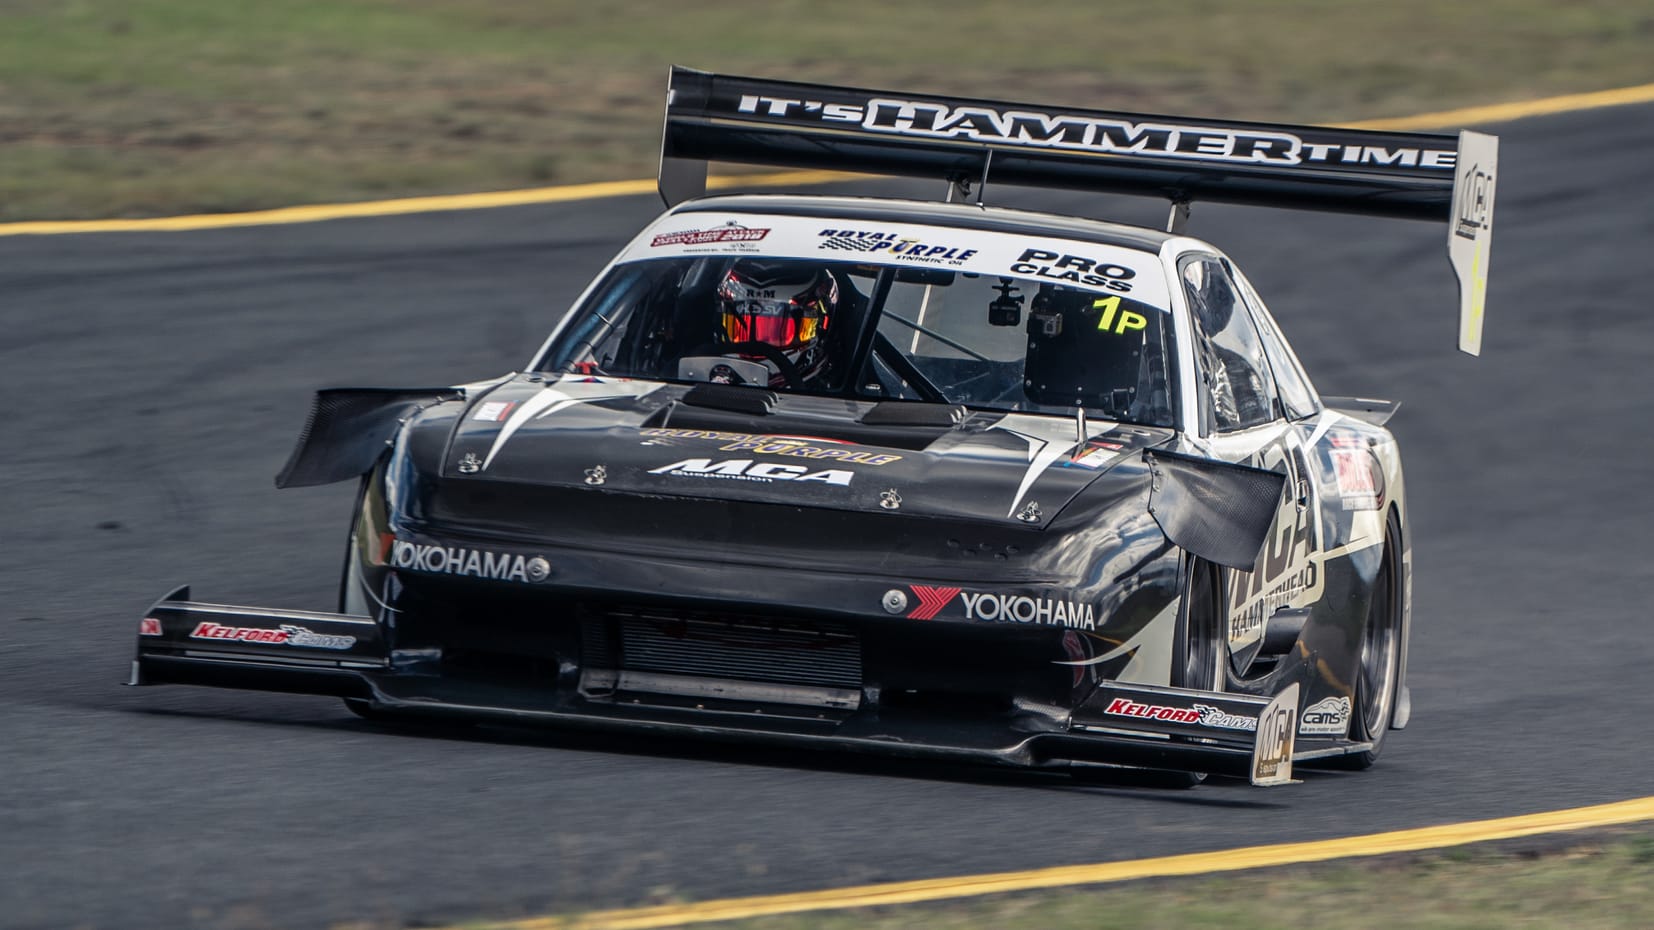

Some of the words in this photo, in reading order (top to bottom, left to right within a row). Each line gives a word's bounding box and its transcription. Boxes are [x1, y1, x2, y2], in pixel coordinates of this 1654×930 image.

[861, 98, 1303, 167] HAMMER
[1301, 142, 1458, 169] TIME
[818, 228, 898, 241] ROYAL
[869, 238, 979, 261] PURPLE
[895, 254, 944, 264] SYNTHETIC
[1016, 248, 1137, 281] PRO
[1009, 263, 1133, 293] CLASS
[1092, 295, 1148, 335] 1P
[639, 428, 769, 443] ROYAL
[719, 434, 903, 466] PURPLE
[647, 458, 855, 487] MCA
[670, 469, 774, 483] Suspension
[960, 592, 1096, 631] YOKOHAMA
[190, 623, 290, 645] KELFORD
[1105, 699, 1200, 723] KELFORD
[1303, 712, 1340, 725] cams
